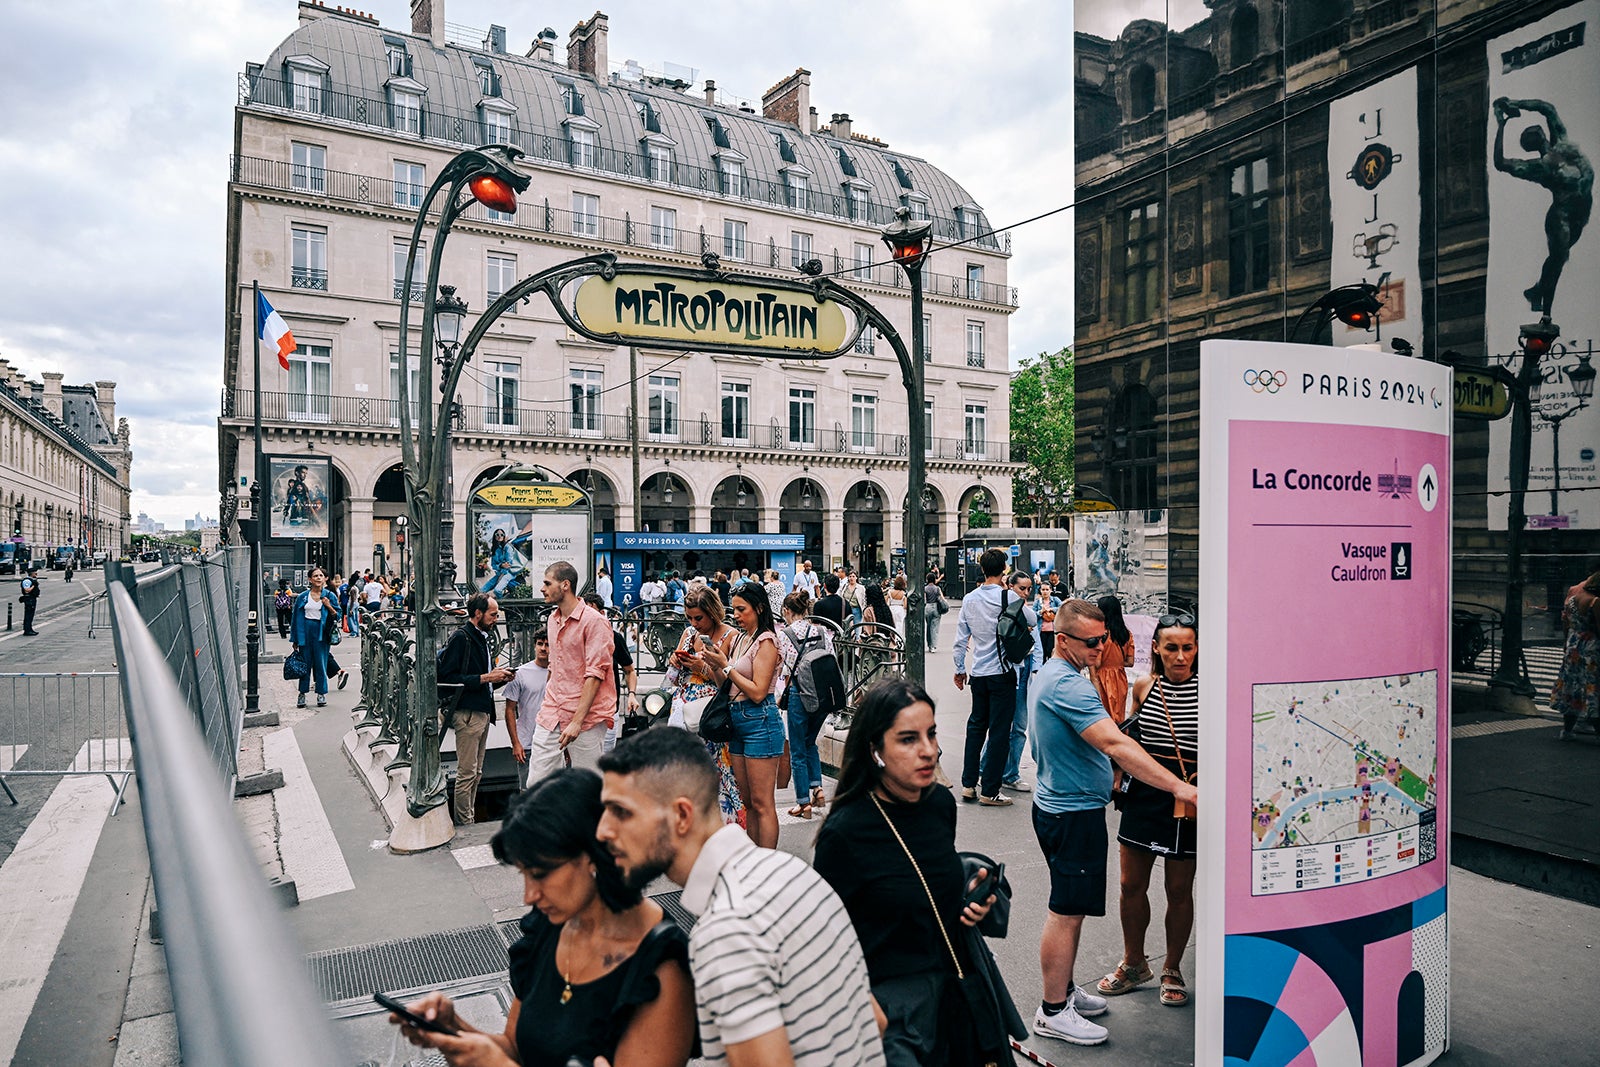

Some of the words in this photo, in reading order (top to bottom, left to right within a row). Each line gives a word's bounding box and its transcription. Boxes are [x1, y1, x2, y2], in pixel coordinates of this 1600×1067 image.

[614, 281, 818, 340] METROPOLITAIN
[1380, 379, 1424, 405] 2024
[1252, 468, 1277, 490] La
[1284, 468, 1372, 492] Concorde
[661, 537, 680, 545] 2024
[1341, 542, 1387, 562] Vasque
[620, 562, 635, 570] VISA
[1331, 565, 1387, 582] Cauldron
